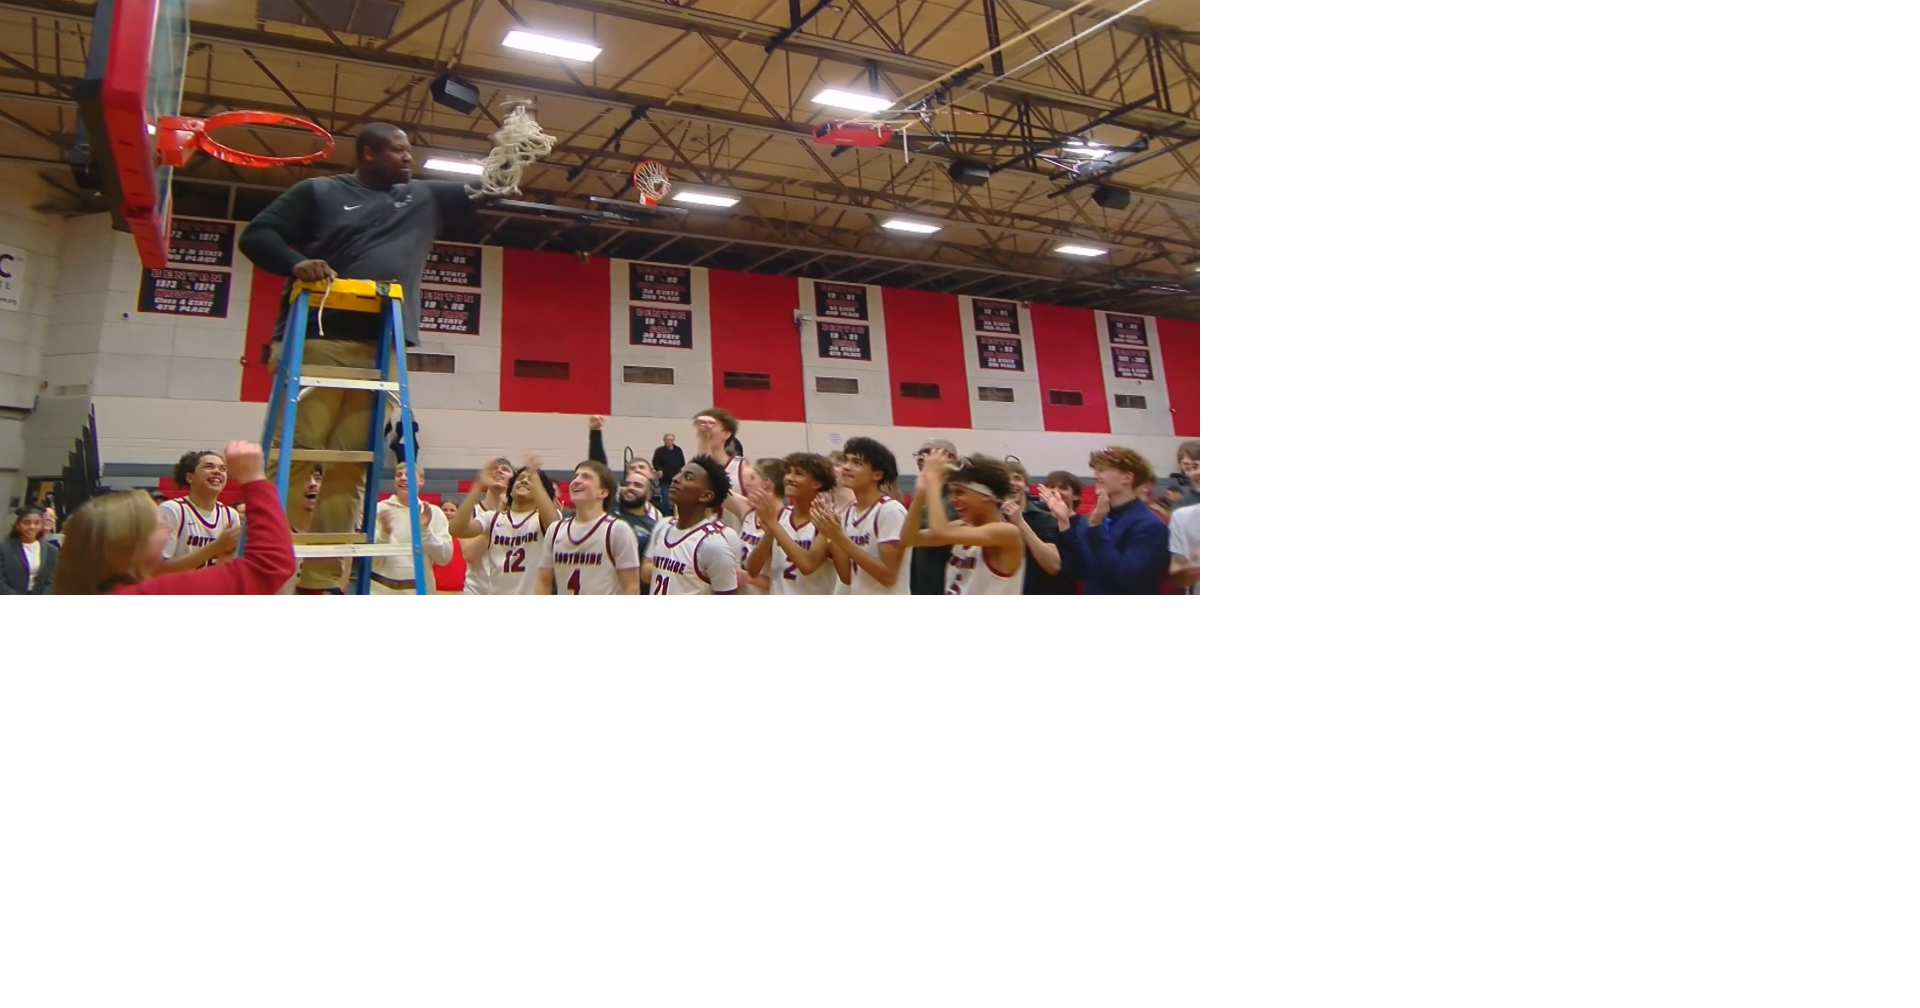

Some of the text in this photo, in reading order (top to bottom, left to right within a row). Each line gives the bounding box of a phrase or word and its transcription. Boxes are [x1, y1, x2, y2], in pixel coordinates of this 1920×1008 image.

[151, 268, 223, 283] BENTON
[439, 270, 468, 279] STATE
[442, 276, 468, 284] PLACE
[155, 279, 216, 292] 1973 1974
[179, 305, 211, 314] PLACE
[187, 300, 214, 308] STATE
[436, 317, 464, 325] STATE
[439, 323, 468, 332] PLACE
[494, 532, 539, 547] SOUTHSIDE
[503, 547, 526, 573] 12
[555, 552, 603, 565] SOUTHSIDE
[567, 568, 581, 595] 4
[653, 574, 670, 595] 21
